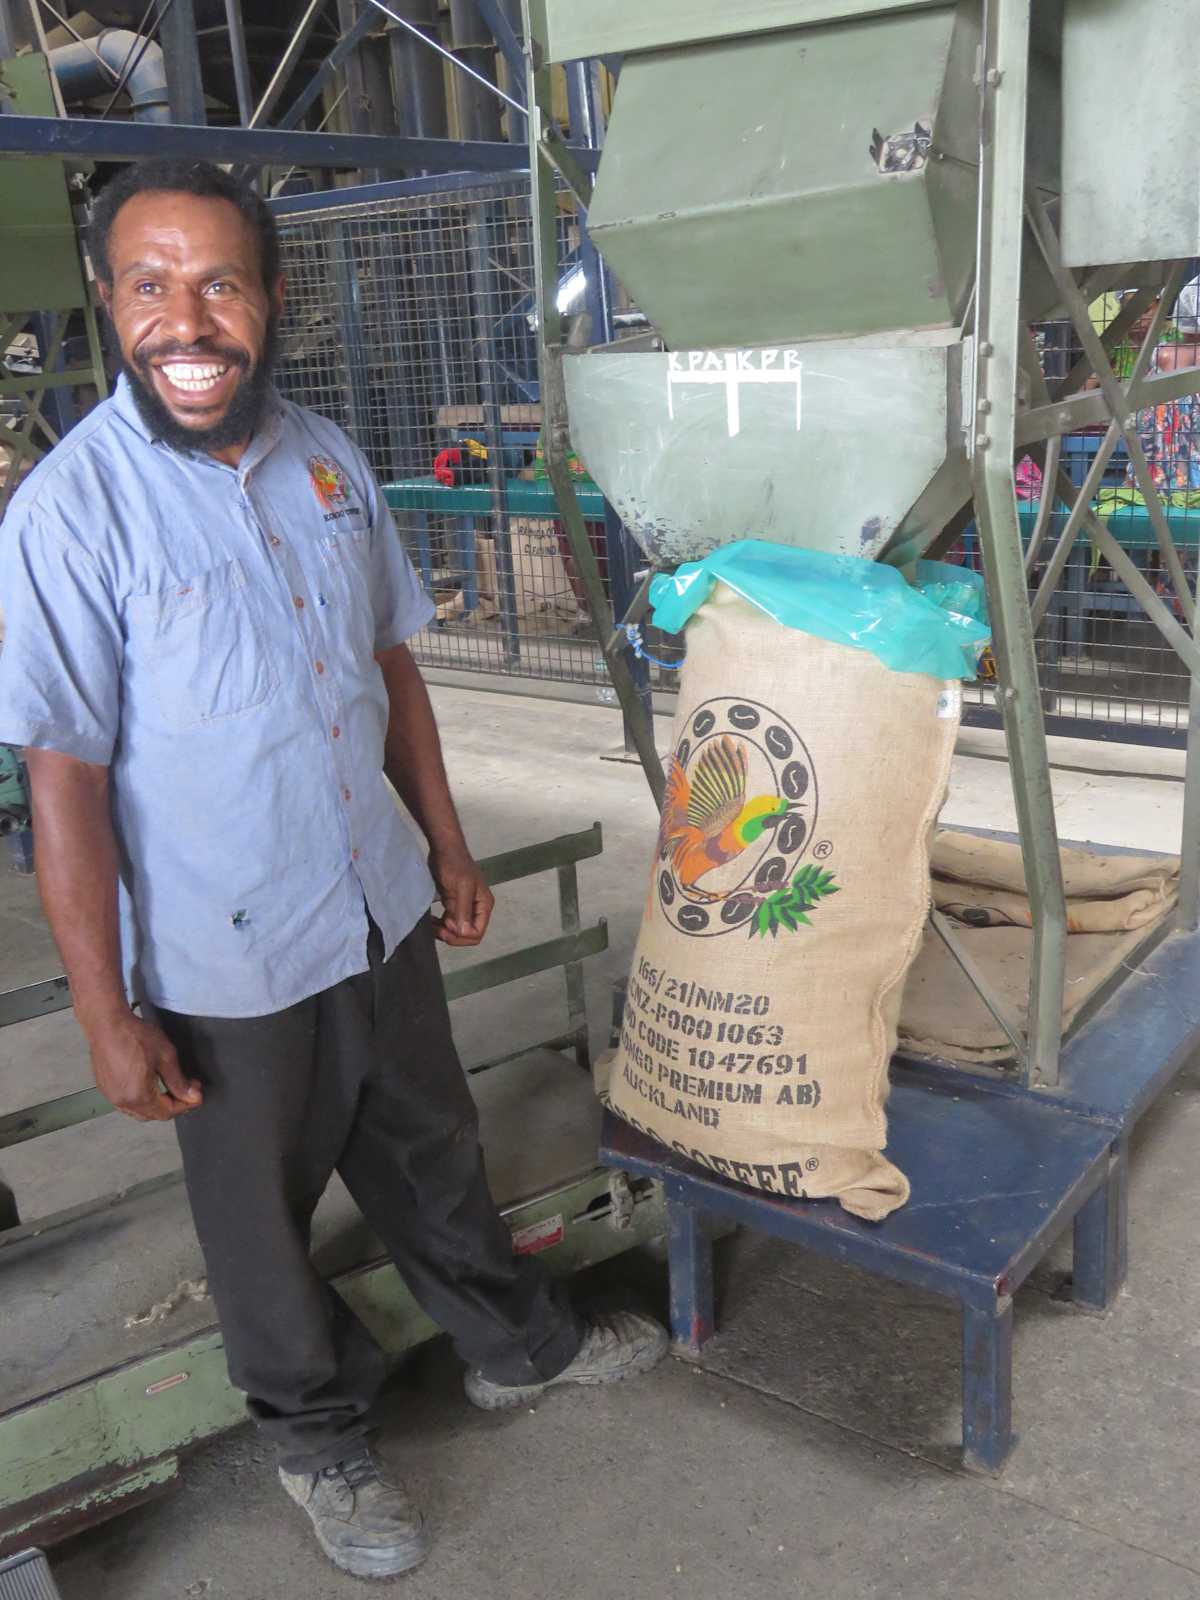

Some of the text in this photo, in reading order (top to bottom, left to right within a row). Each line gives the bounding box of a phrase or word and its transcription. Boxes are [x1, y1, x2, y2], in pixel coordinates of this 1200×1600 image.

[638, 1020, 680, 1061] CODE
[688, 1047, 807, 1076] 1047691
[623, 1060, 721, 1129] AUCKLAND
[658, 1063, 762, 1105] PREMIUM
[776, 1080, 822, 1109] AB)
